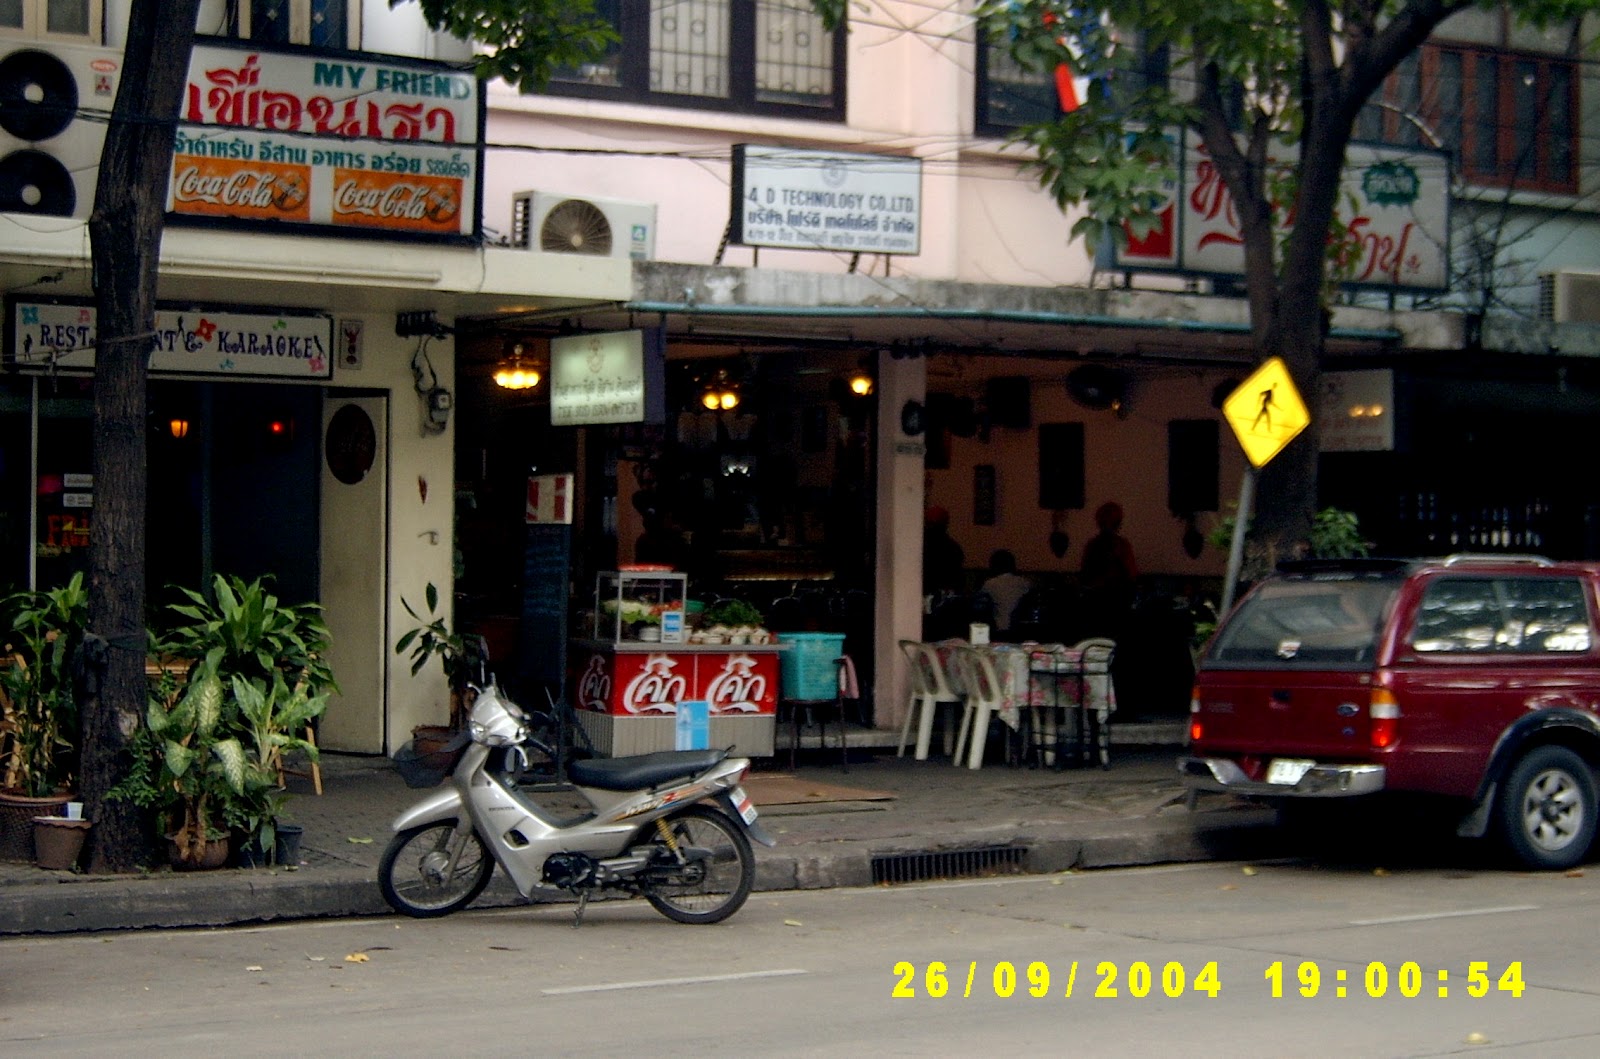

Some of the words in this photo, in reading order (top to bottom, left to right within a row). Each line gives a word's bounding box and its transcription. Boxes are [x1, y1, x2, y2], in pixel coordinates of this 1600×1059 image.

[314, 62, 366, 89] MY
[376, 69, 470, 99] FRIEND
[259, 140, 306, 165] อีสาน
[312, 150, 365, 169] อาหาร
[371, 152, 421, 173] อร่อย
[175, 166, 277, 208] Coca-Cola
[334, 180, 431, 220] Coca-Cola
[766, 188, 775, 203] D
[781, 189, 864, 209] TECHNOLOGY
[40, 324, 175, 351] RESTNT
[218, 331, 314, 359] KARAOKE
[623, 657, 687, 714] โค้ก
[705, 657, 767, 714] โค้ก
